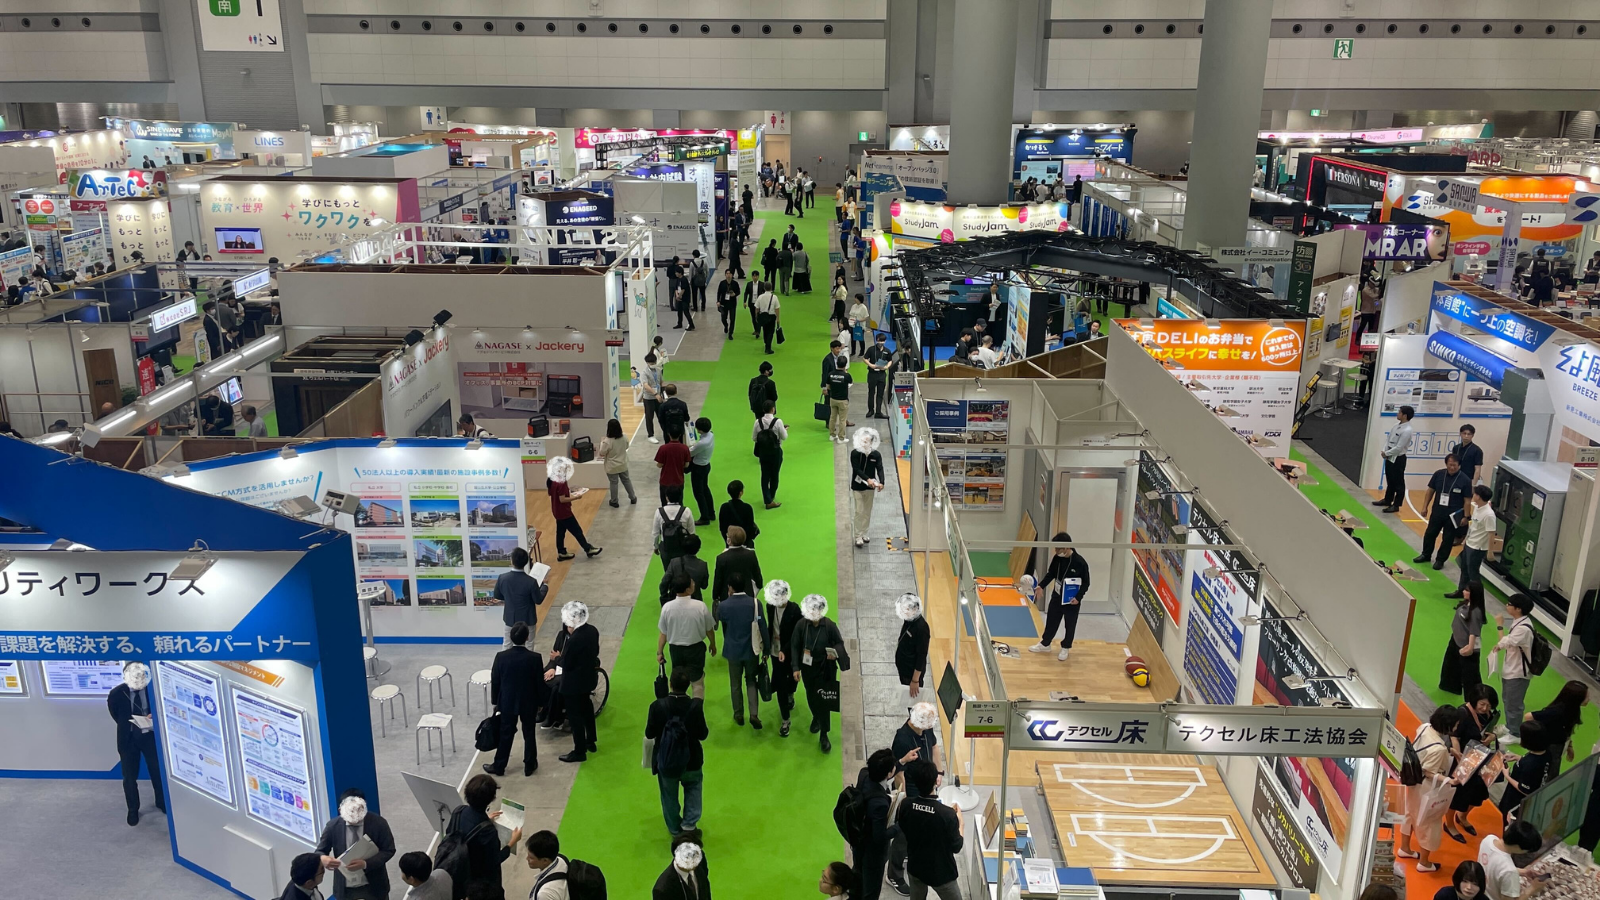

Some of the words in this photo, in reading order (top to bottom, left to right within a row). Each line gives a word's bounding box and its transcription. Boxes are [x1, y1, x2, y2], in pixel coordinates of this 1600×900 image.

[254, 137, 285, 146] LINES
[1335, 171, 1360, 187] PERSONA
[1451, 183, 1477, 203] SANWA
[242, 203, 263, 213] 世界
[302, 199, 360, 208] 学びにもっと
[570, 205, 598, 213] ENAGEED
[1449, 200, 1475, 211] SUPPLY
[116, 213, 141, 222] 学びに
[905, 218, 939, 229] StudyJam
[963, 221, 1009, 232] StudyJam
[119, 228, 142, 236] もっと
[1383, 228, 1425, 236] 体験コーナー
[121, 241, 144, 250] もっと
[1365, 238, 1396, 257] MR
[1396, 238, 1427, 257] AR
[423, 334, 449, 364] Jackery
[535, 341, 585, 353] Jackery
[1429, 340, 1457, 363] SINKO
[394, 359, 418, 385] NAGASE
[1572, 383, 1599, 402] BREEZE
[978, 716, 994, 724] 7-6
[1179, 725, 1369, 746] テクセル床工法協会
[912, 803, 935, 814] TECCELL
